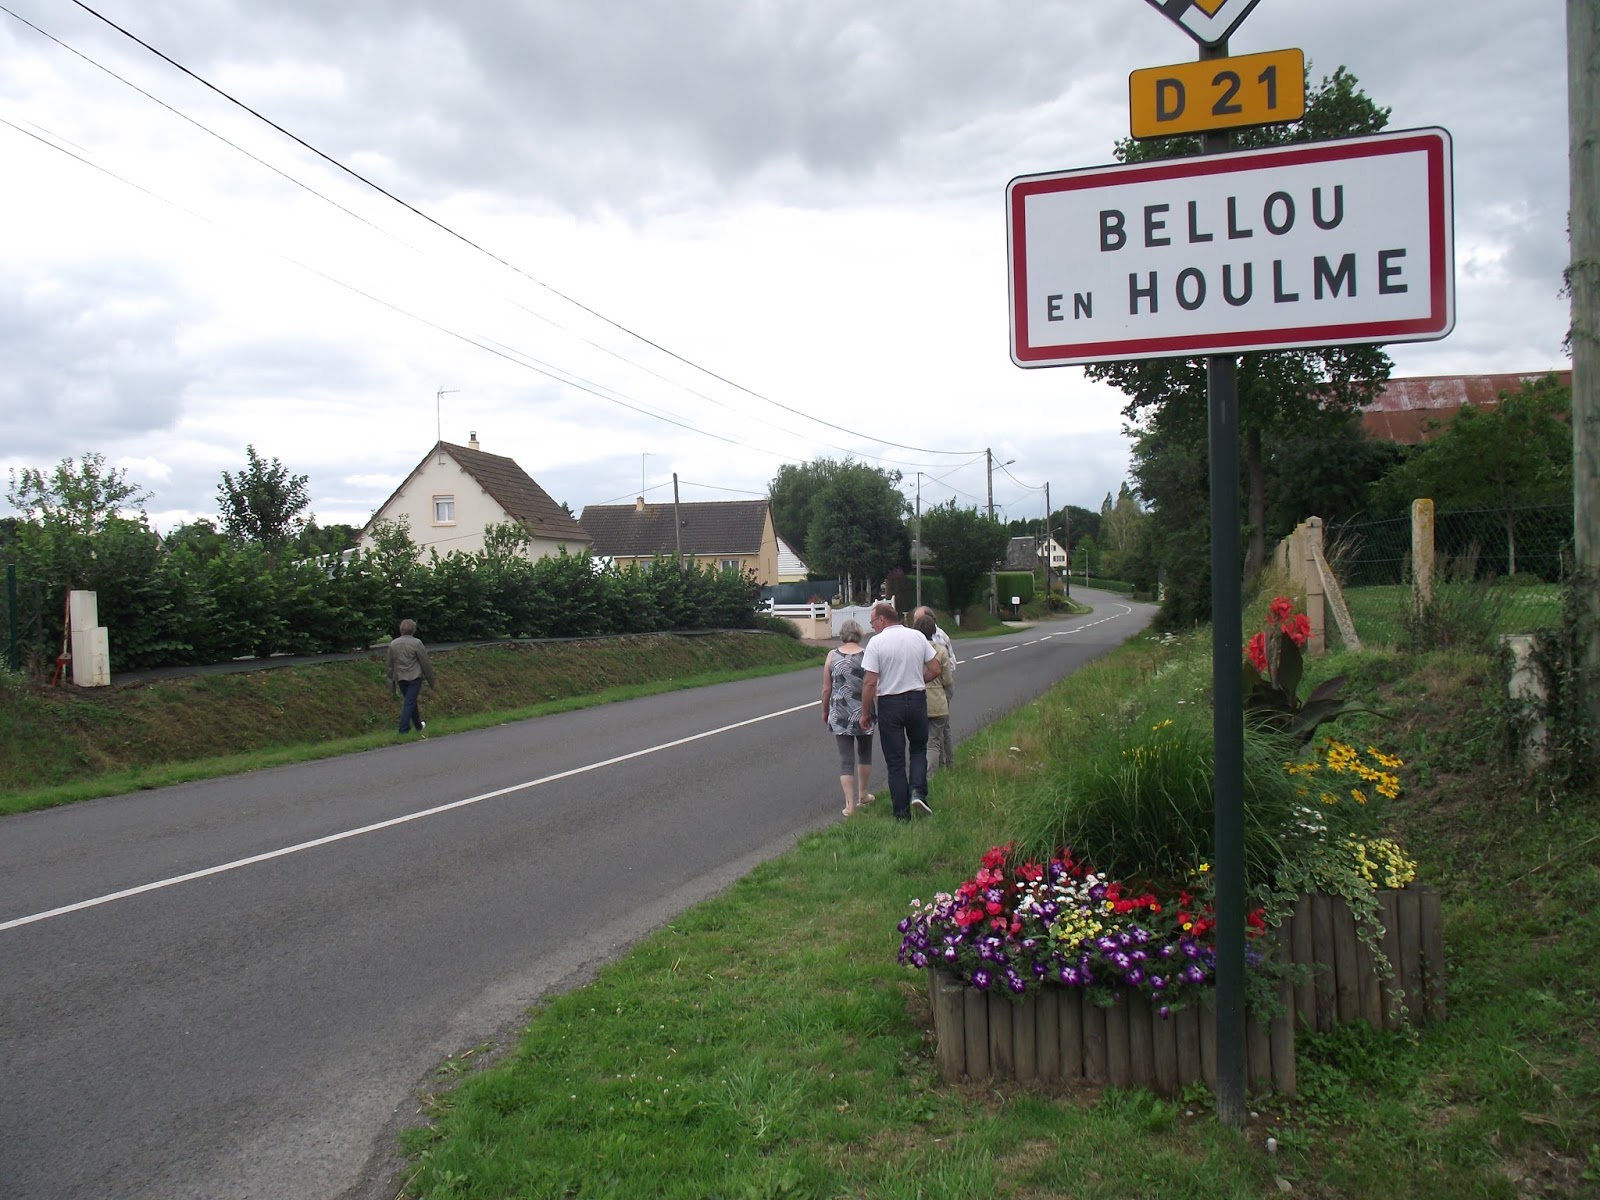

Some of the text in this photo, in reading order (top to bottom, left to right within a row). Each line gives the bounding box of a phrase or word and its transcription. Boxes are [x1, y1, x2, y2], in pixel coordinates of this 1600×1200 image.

[1155, 65, 1278, 123] D 21
[1099, 184, 1344, 253] BELLOU
[1047, 247, 1408, 322] EN HOULME
